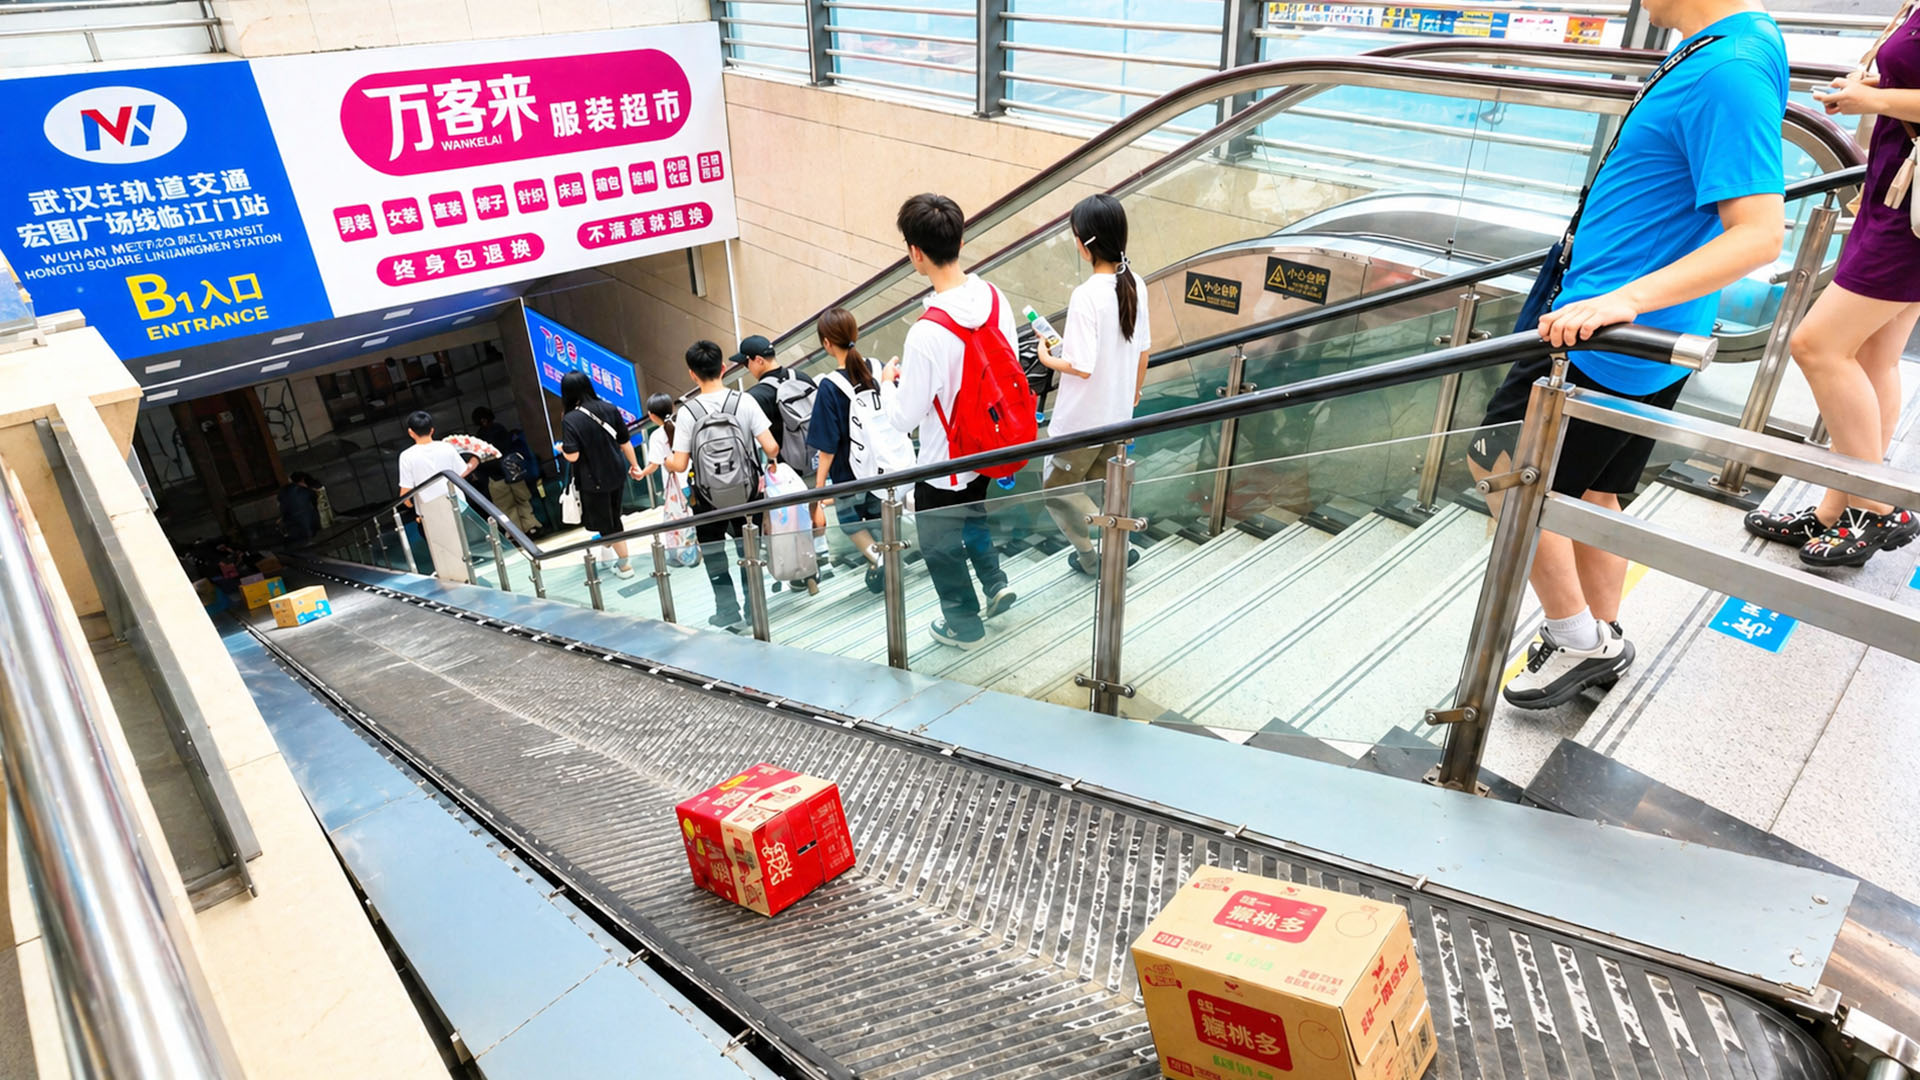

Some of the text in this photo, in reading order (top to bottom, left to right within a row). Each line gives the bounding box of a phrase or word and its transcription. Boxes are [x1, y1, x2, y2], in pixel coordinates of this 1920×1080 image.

[362, 74, 680, 161] 万客来 服装超市
[441, 135, 502, 150] WANKELAI
[339, 214, 372, 234] 男装
[387, 207, 418, 226] 女装
[518, 186, 546, 205] 针织
[559, 180, 585, 198] 床品
[25, 263, 84, 279] HONGTU
[87, 254, 142, 270] SQUARE
[234, 234, 281, 248] STATION
[41, 247, 106, 264] WUHAN
[393, 239, 531, 280] 终身包退换
[147, 306, 268, 340] ENTRANCE
